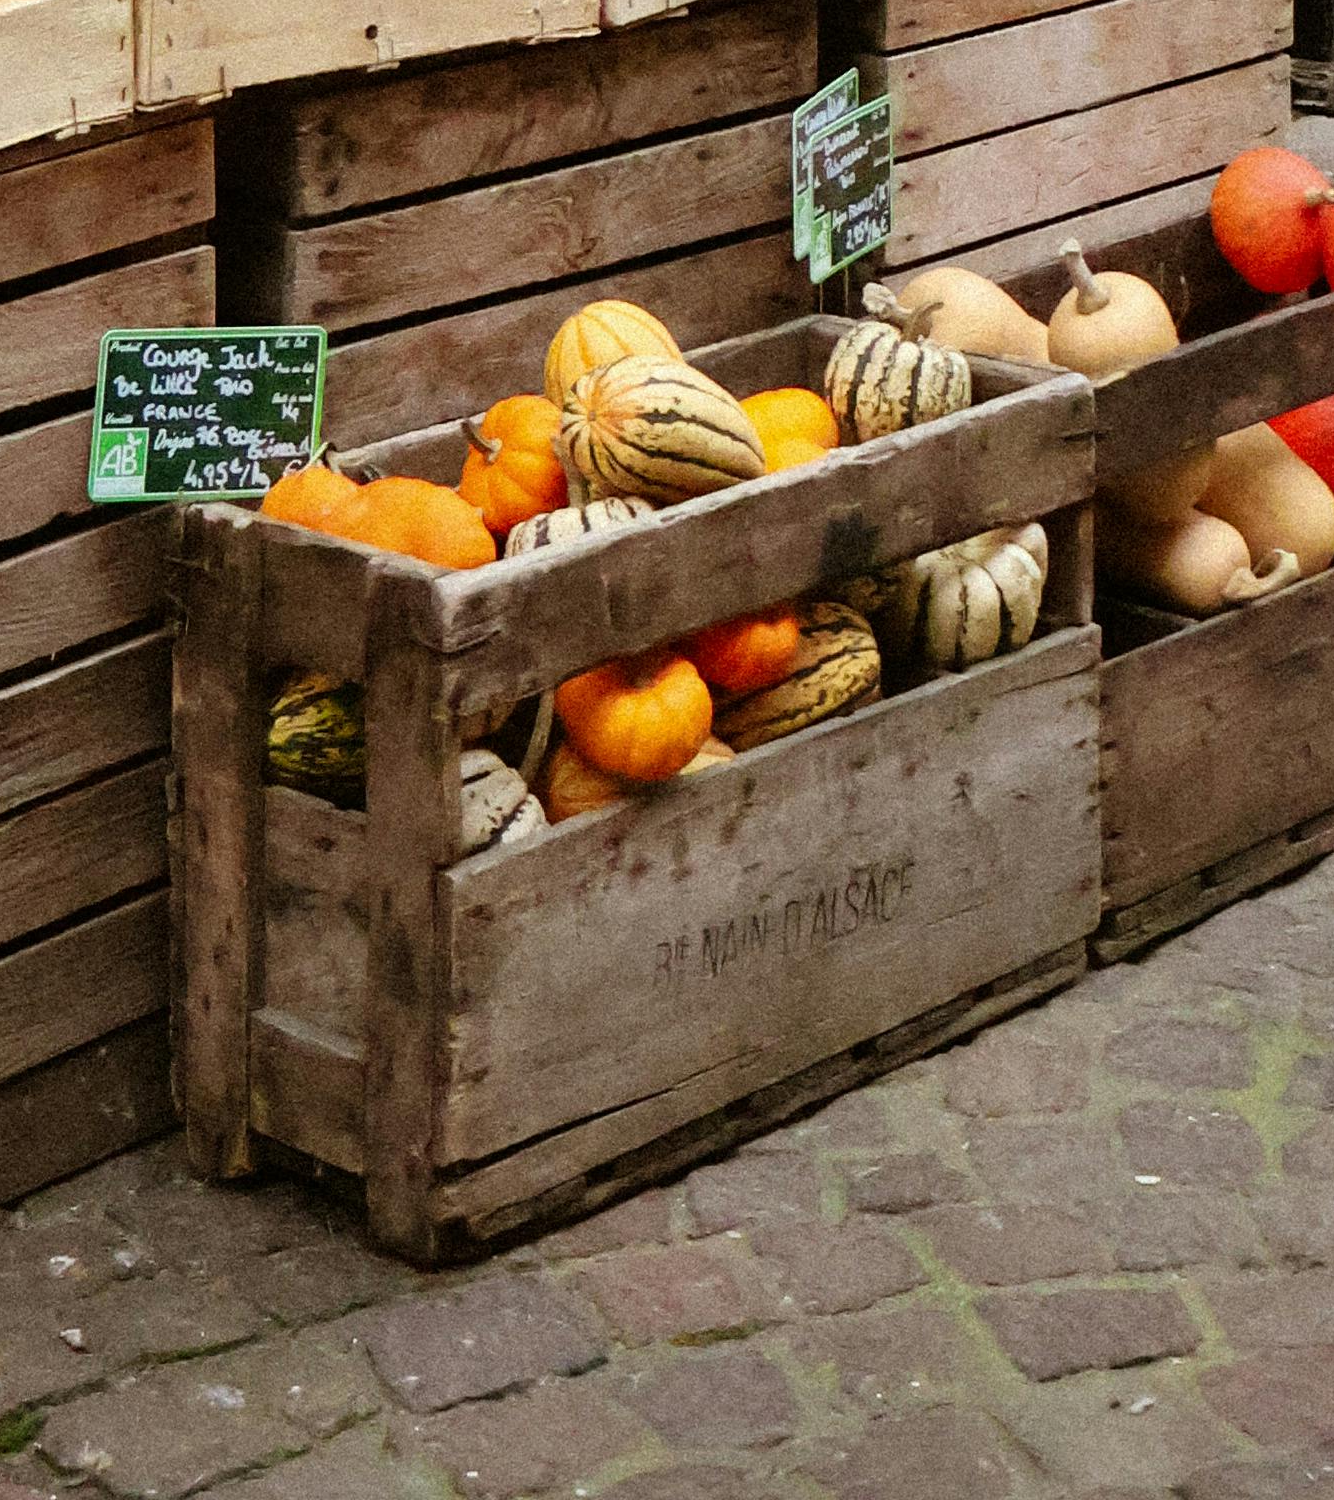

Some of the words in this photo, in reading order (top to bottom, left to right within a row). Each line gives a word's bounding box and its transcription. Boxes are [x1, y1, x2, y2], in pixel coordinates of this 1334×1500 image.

[142, 342, 214, 383] Courge
[218, 339, 276, 372] Jack
[213, 373, 255, 398] Bio
[141, 402, 223, 423] FRANCE
[98, 443, 139, 477] AB
